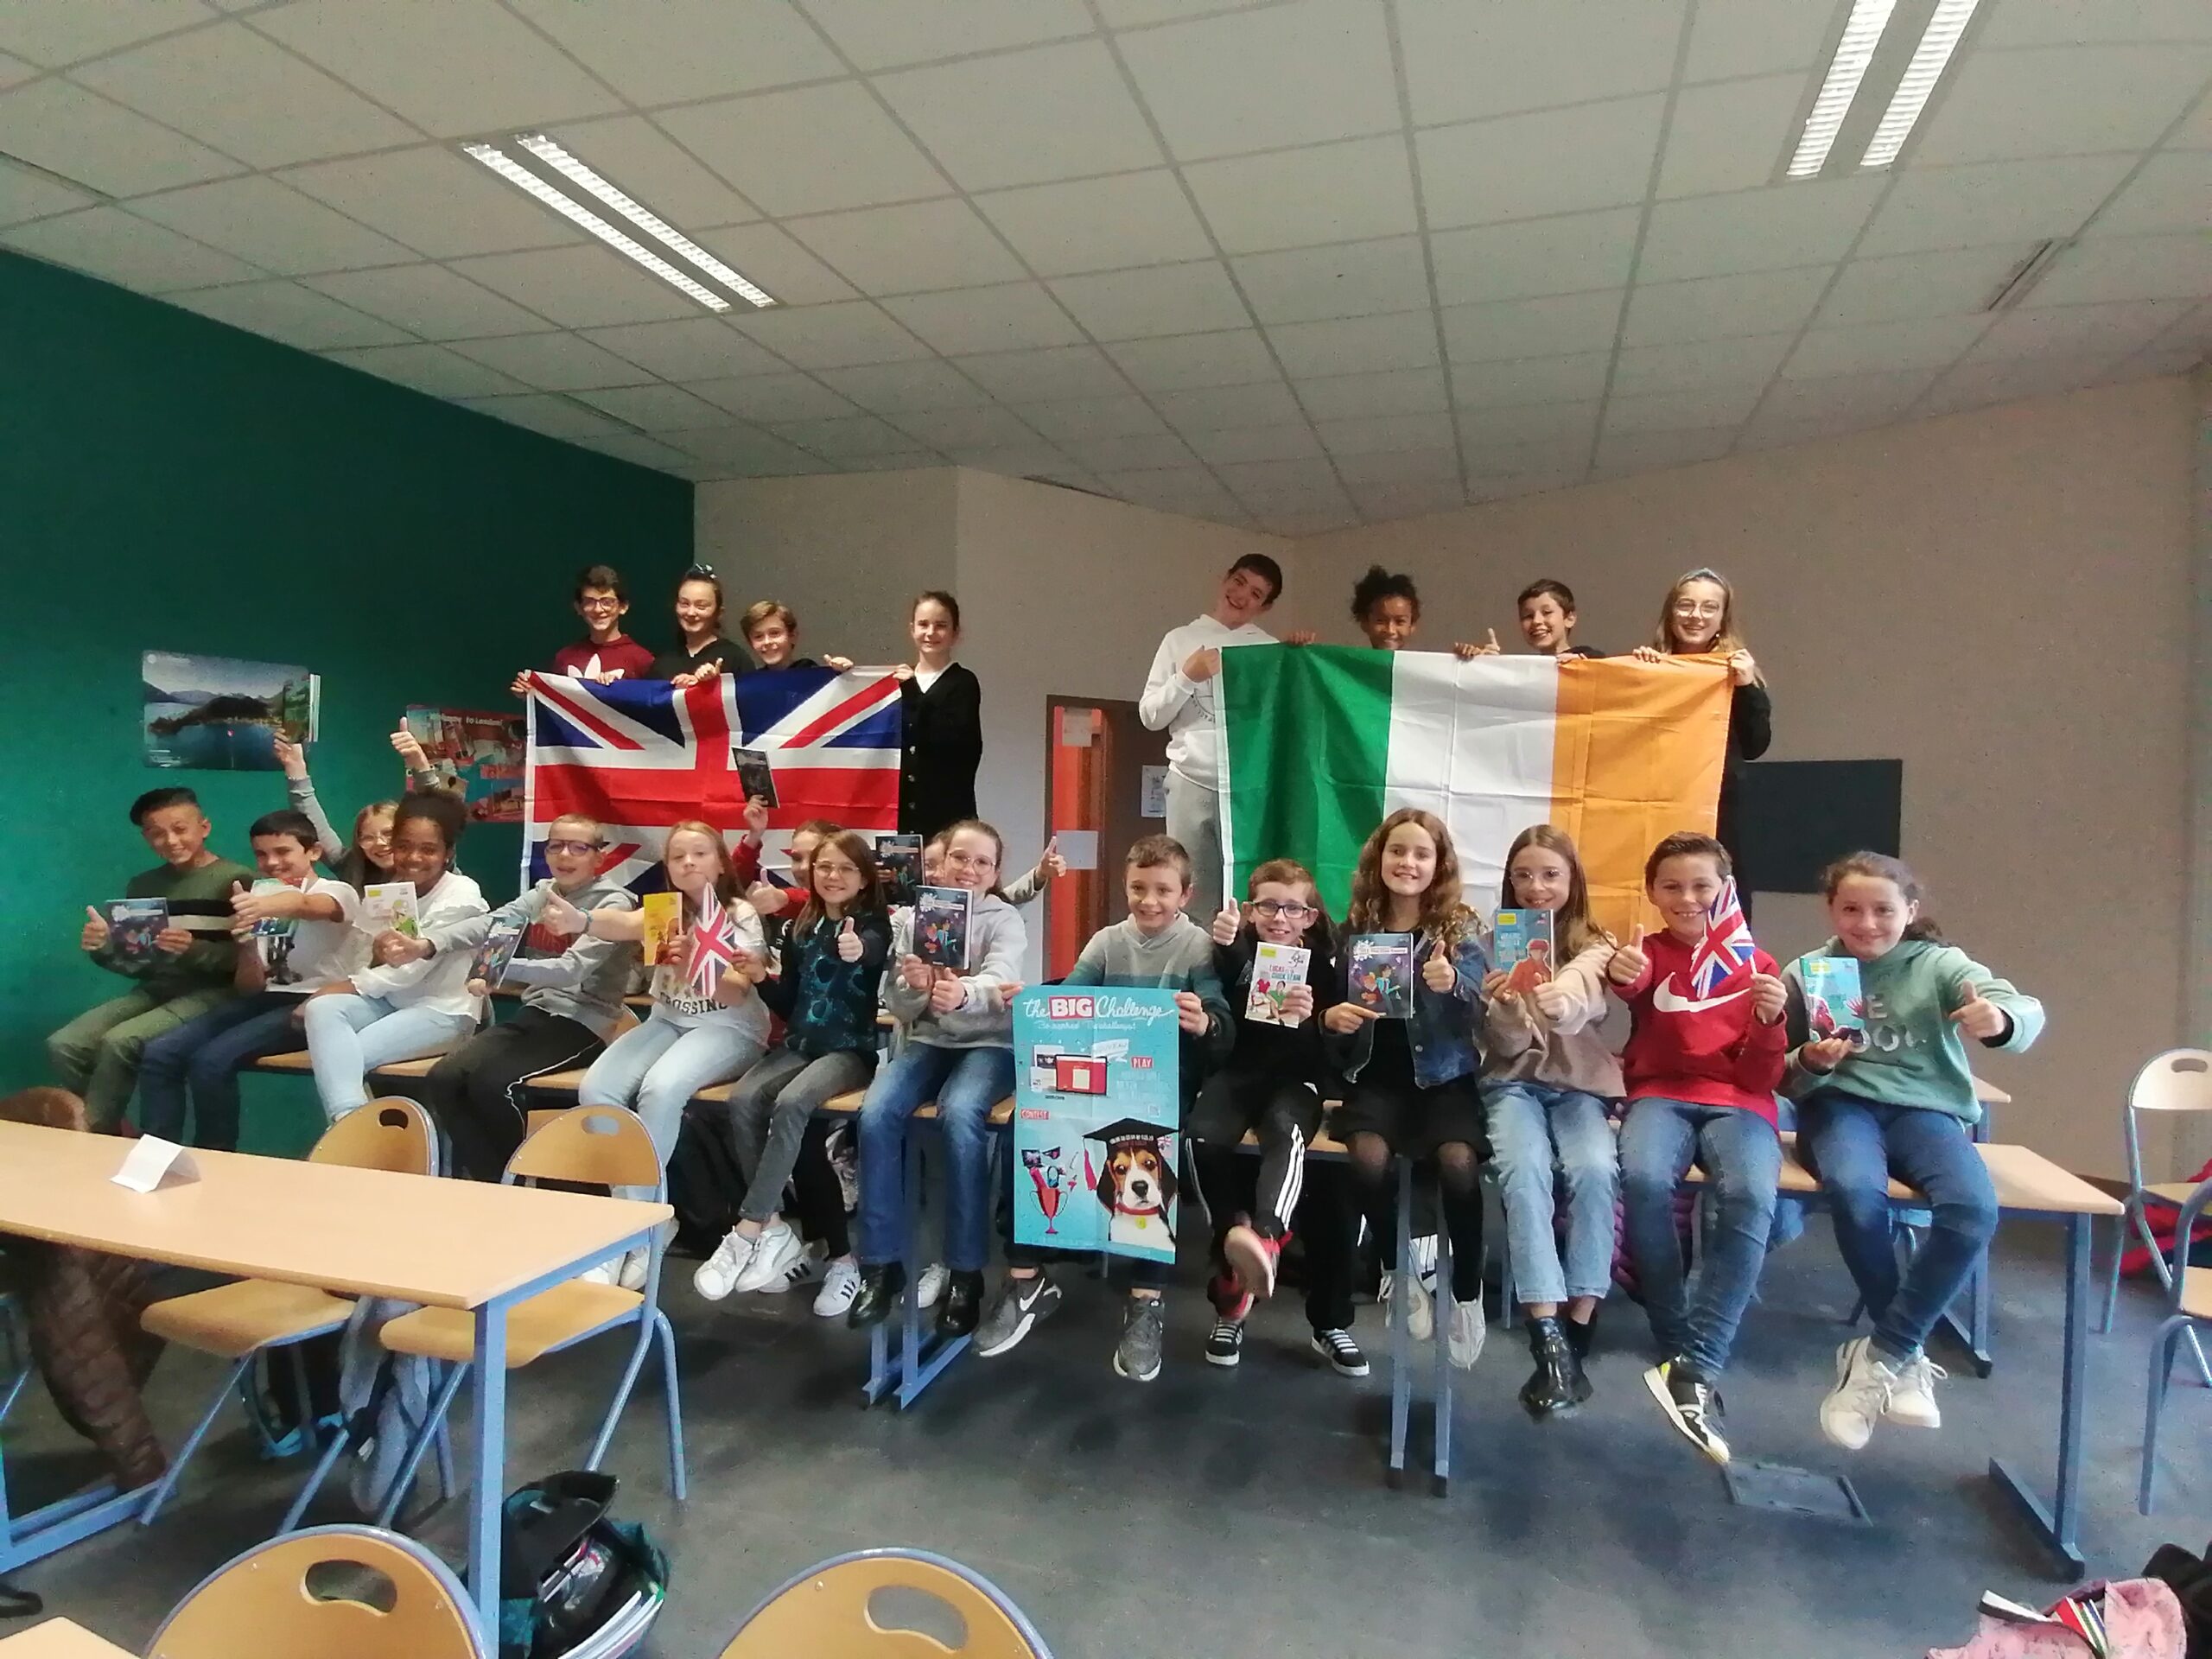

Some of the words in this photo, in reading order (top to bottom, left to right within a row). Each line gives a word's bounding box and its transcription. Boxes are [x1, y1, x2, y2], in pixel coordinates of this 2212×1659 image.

[1023, 998, 1050, 1018] the
[1051, 998, 1093, 1018] BIG
[1095, 995, 1175, 1027] Challenge
[1133, 1057, 1152, 1069] PLAY
